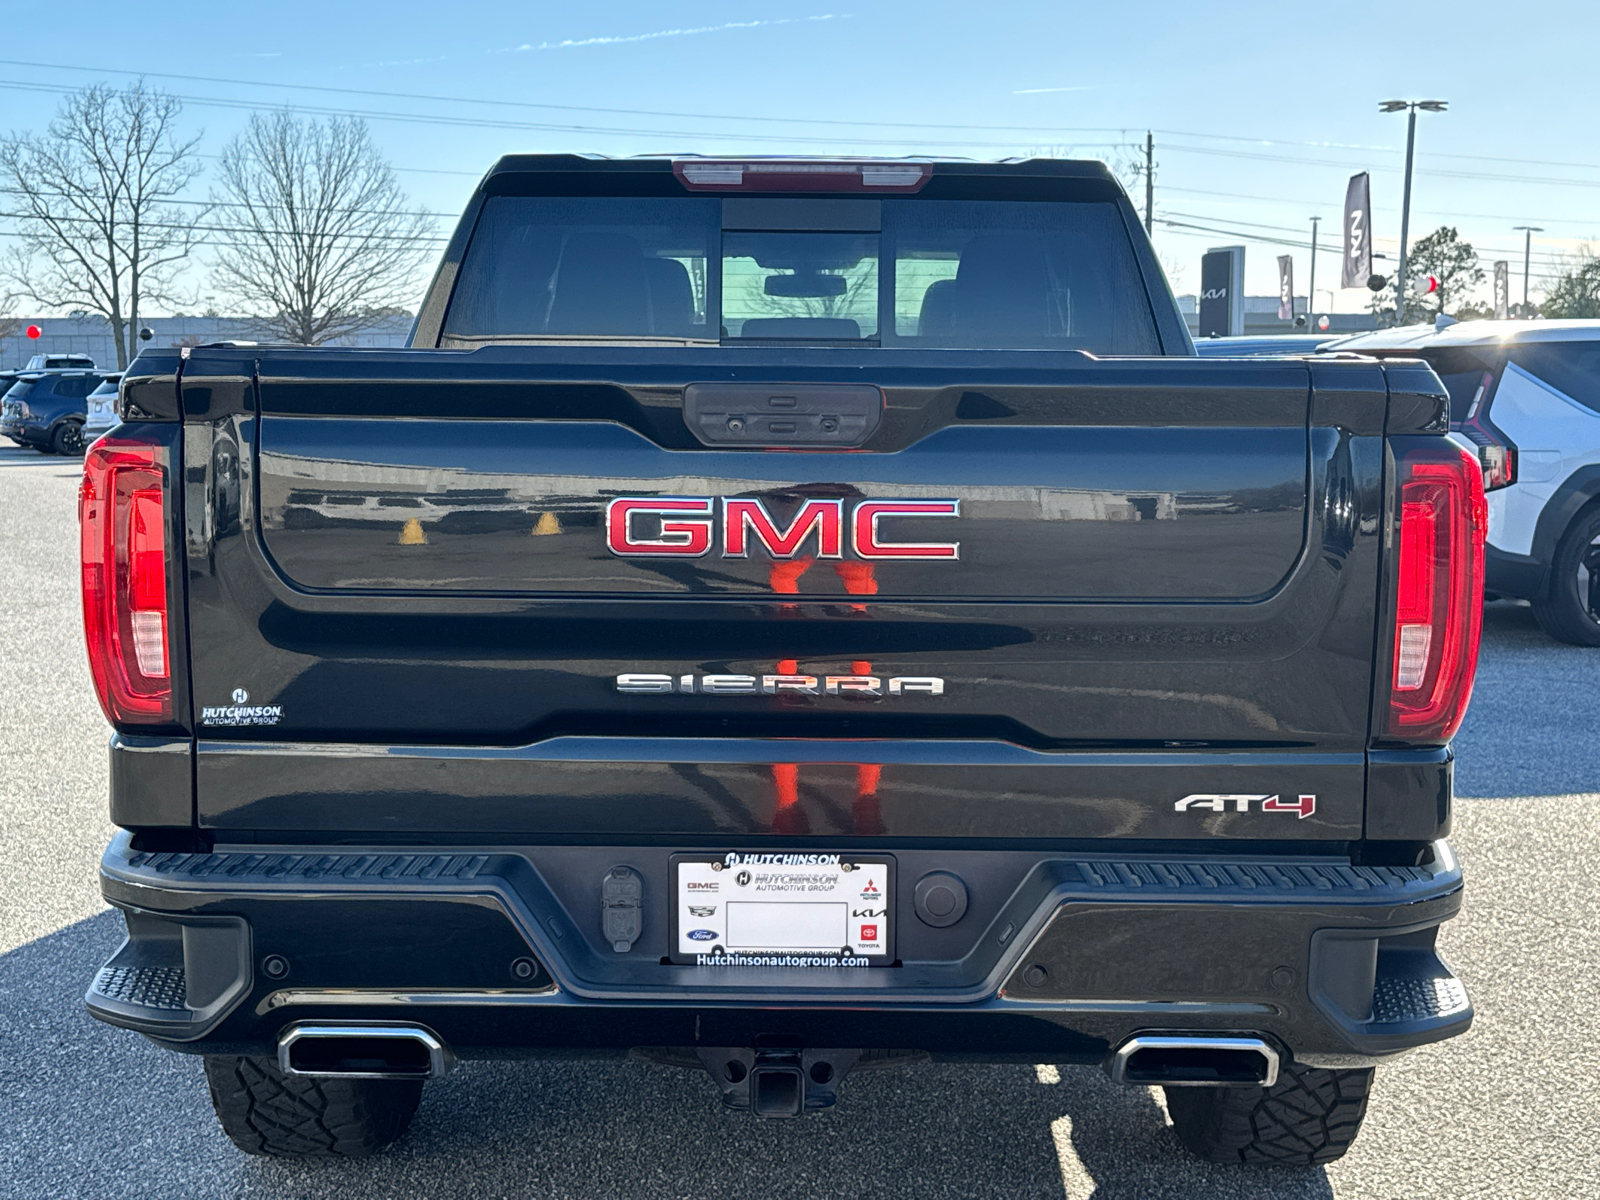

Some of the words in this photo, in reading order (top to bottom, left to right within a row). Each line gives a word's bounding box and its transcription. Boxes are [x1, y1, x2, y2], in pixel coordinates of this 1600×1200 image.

[1201, 288, 1226, 299] KIA
[606, 497, 960, 560] GMC
[616, 673, 945, 697] SIERRA
[202, 706, 281, 718] HUTCHINSON
[203, 717, 251, 725] AUTOMOTIVE
[252, 717, 278, 725] GROUP
[1174, 794, 1316, 819] AT4
[743, 854, 840, 865] HUTCHINSON
[755, 873, 839, 884] HUTCHINSON
[756, 884, 806, 892] AUTOMOTIVE
[807, 884, 835, 892] GROUP
[852, 909, 887, 917] KIA
[692, 930, 713, 940] Ford
[696, 954, 869, 967] Hutchinsonautogroup.com
